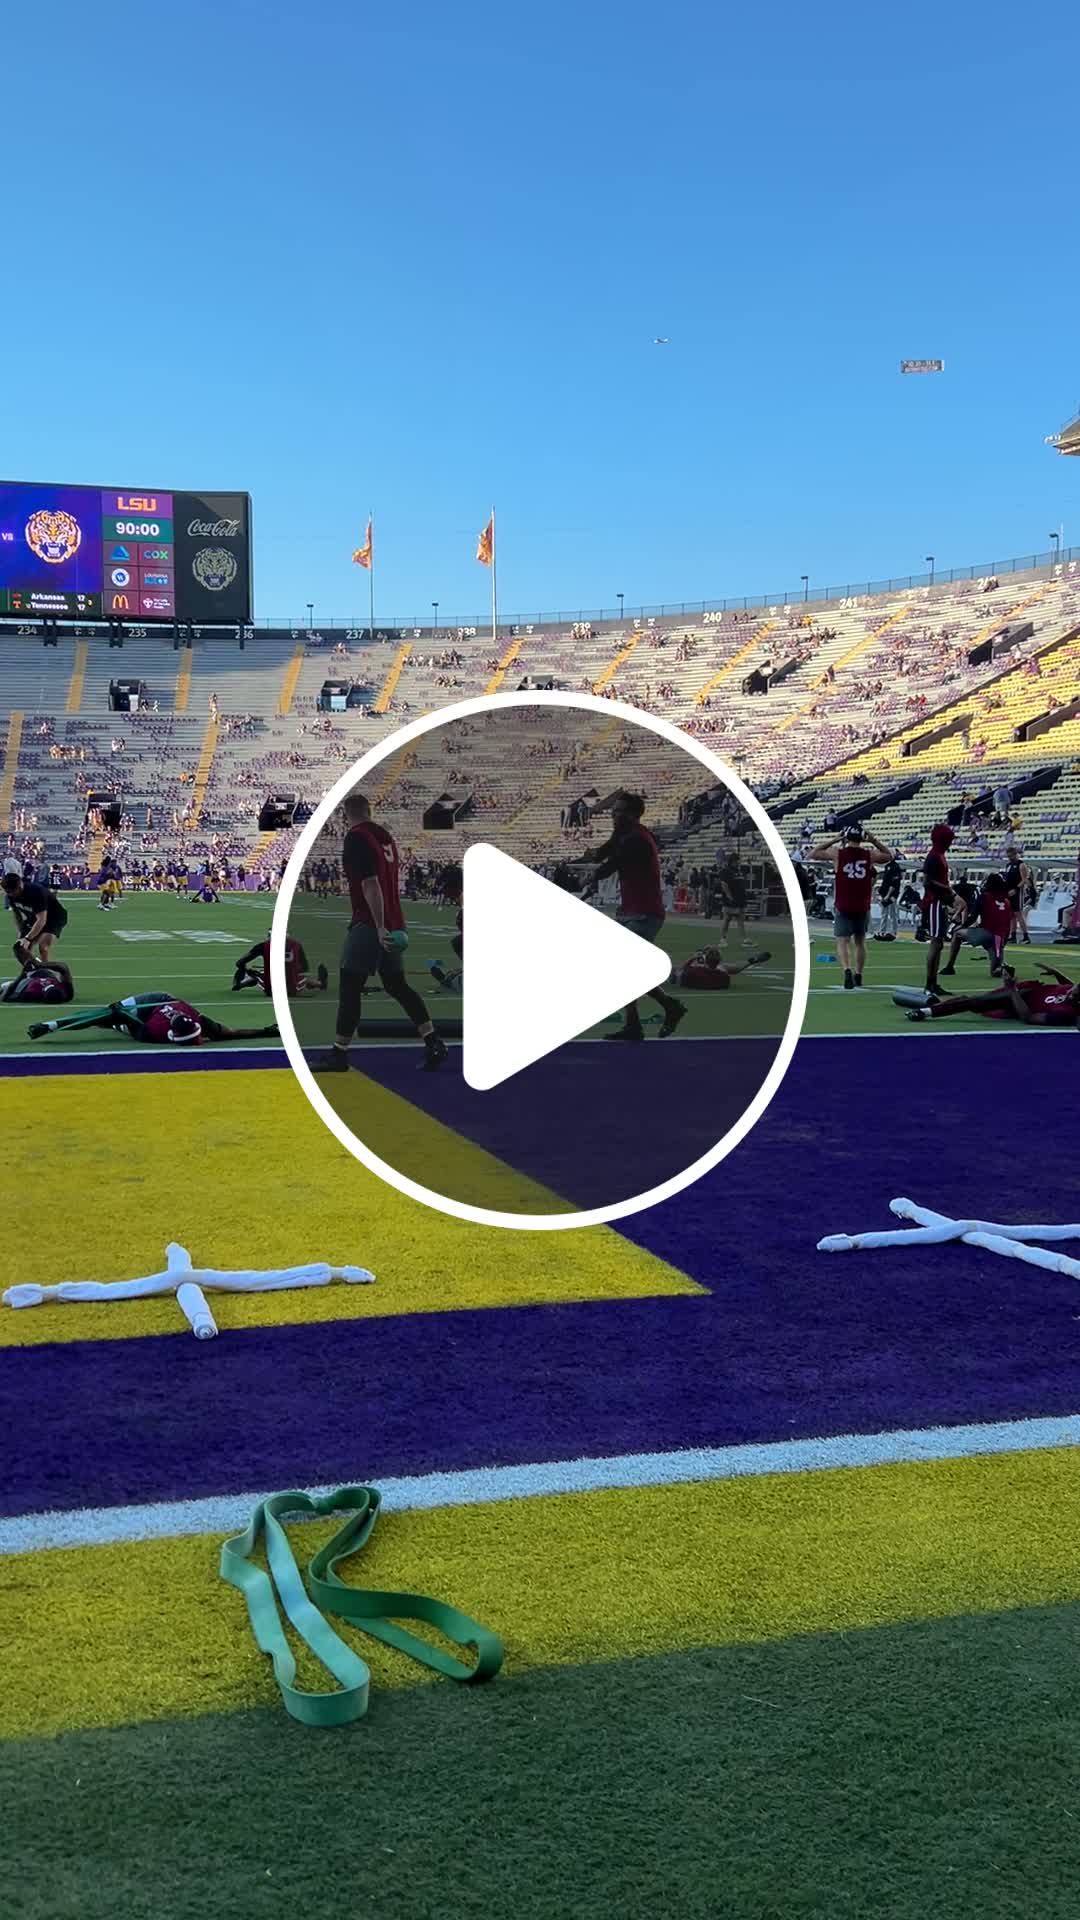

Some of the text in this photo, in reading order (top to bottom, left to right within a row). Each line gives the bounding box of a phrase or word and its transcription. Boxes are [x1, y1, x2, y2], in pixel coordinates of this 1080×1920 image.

[117, 496, 157, 512] LSU
[115, 522, 160, 536] 90:00
[143, 550, 169, 560] COX
[31, 593, 66, 601] Arkansas
[31, 601, 69, 610] Tennessee
[839, 597, 858, 609] 241
[703, 612, 722, 624] 240
[16, 625, 38, 635] 234
[128, 628, 147, 638] 235
[346, 629, 364, 640] 237
[842, 859, 868, 880] 45
